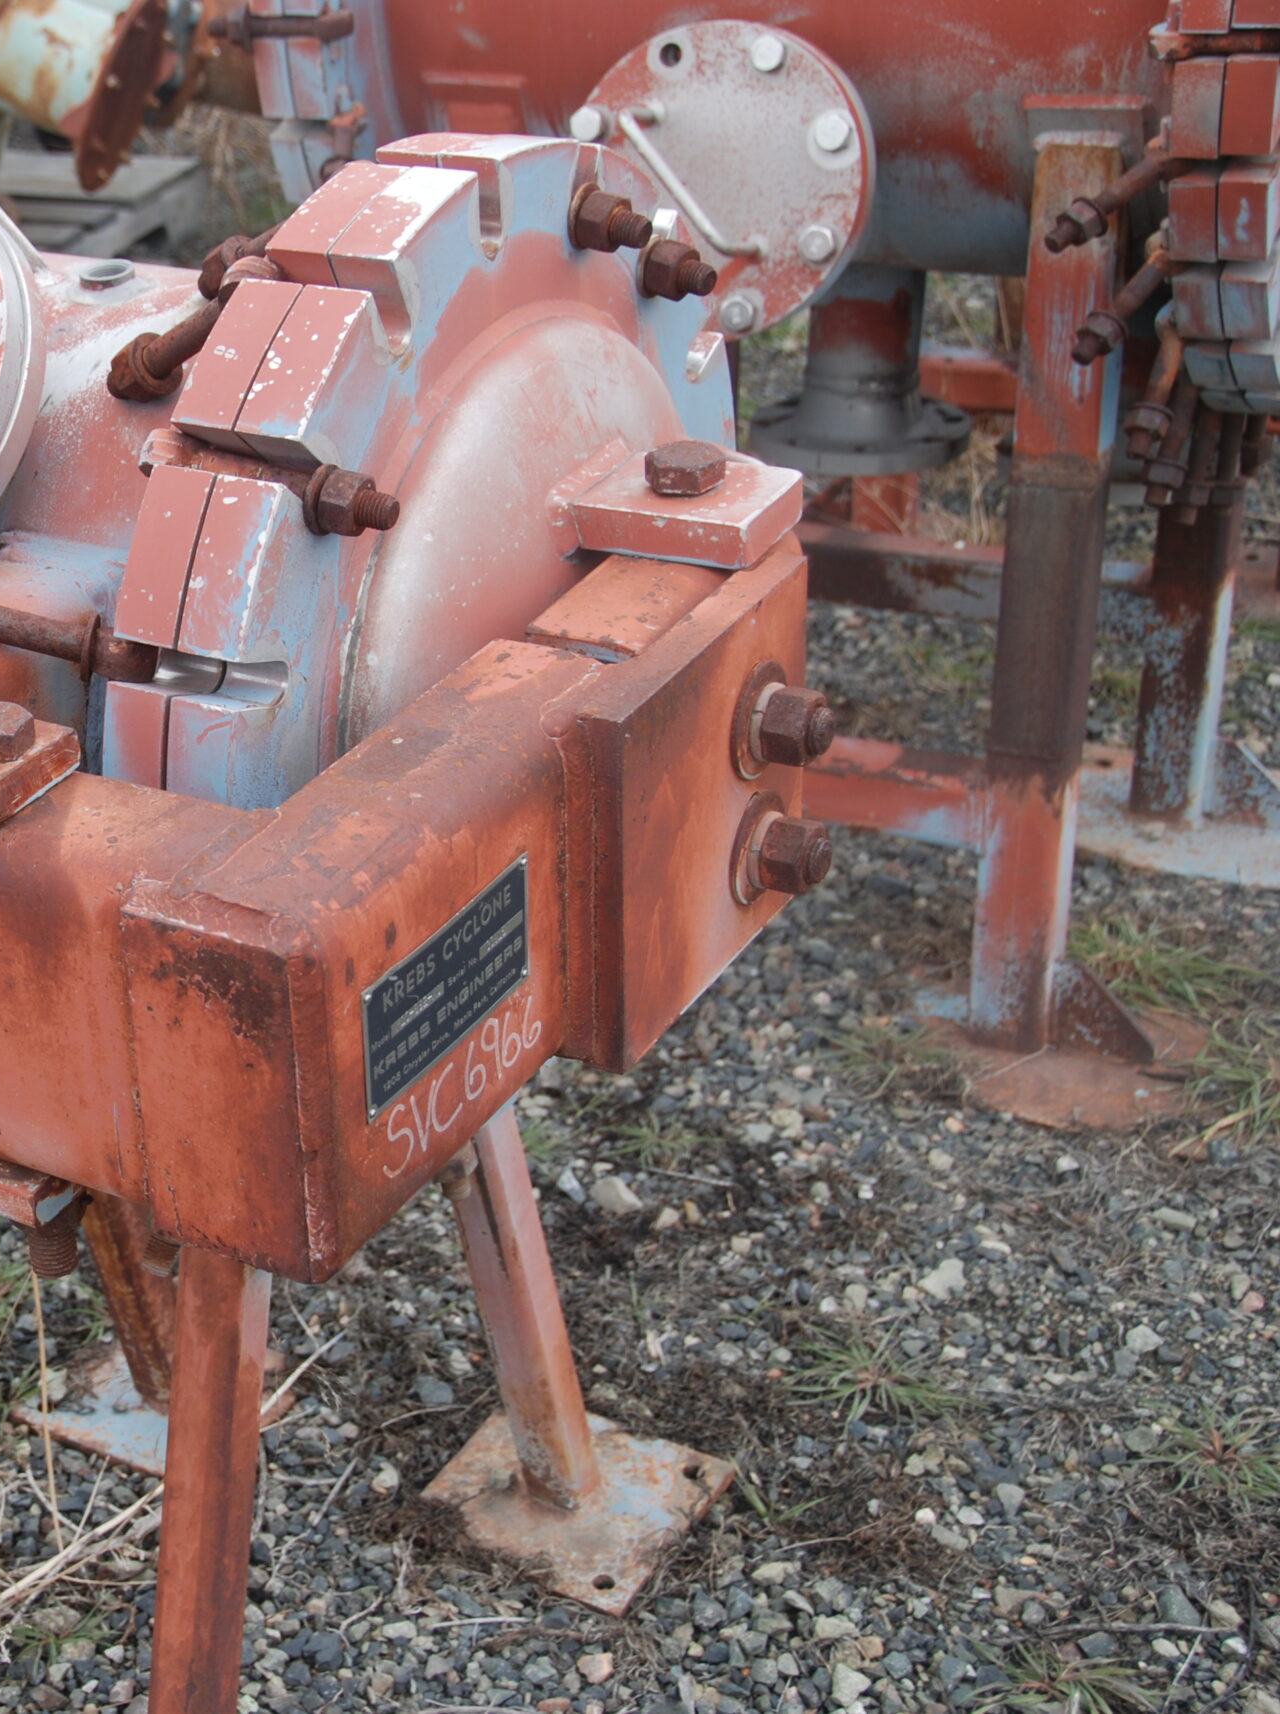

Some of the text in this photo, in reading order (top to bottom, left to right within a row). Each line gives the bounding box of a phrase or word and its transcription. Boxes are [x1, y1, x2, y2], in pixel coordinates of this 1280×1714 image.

[373, 1020, 431, 1080] KREBS
[436, 935, 523, 1026] ENGINEERS
[381, 952, 436, 1014] KREBS
[441, 883, 512, 961] CYCLONE
[446, 964, 467, 988] Serial
[383, 1062, 463, 1178] SVC
[464, 995, 542, 1101] 6966
